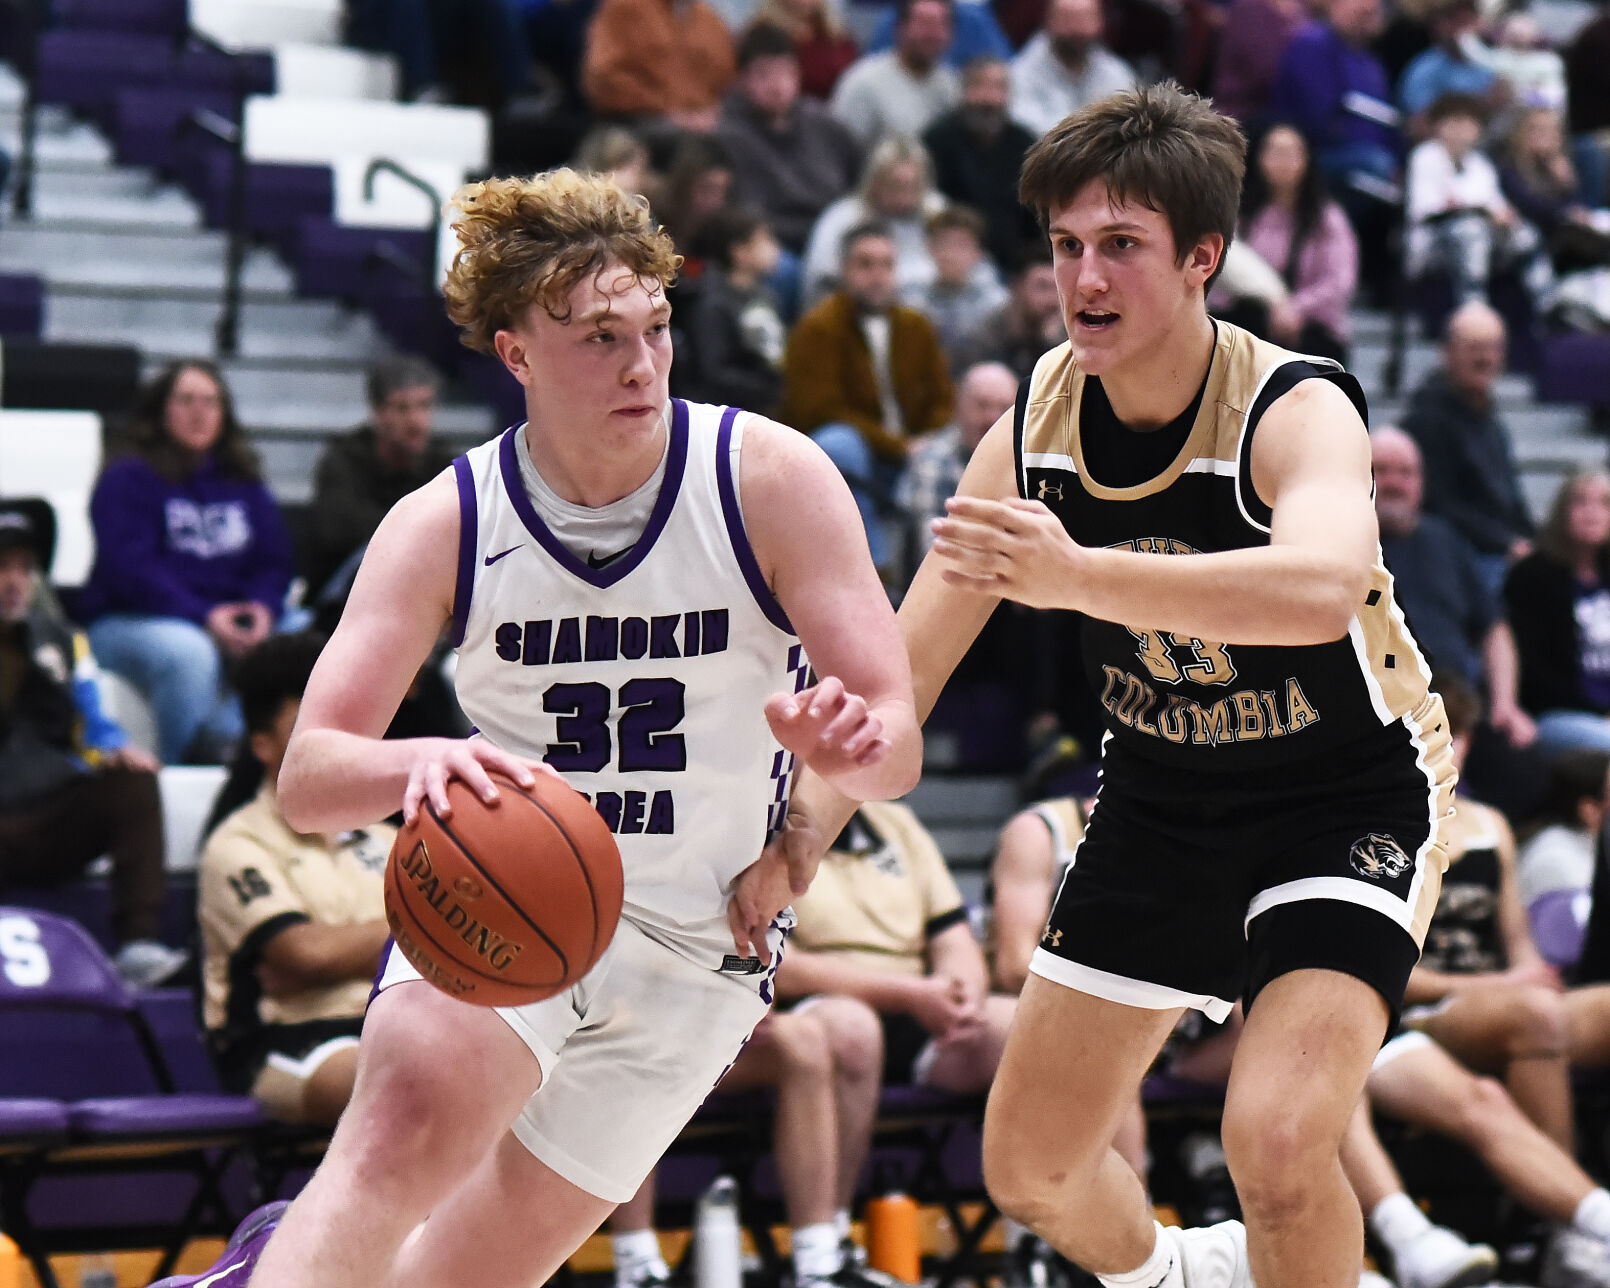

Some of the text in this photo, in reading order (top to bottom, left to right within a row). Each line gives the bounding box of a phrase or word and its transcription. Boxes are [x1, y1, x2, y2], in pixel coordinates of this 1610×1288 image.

[495, 608, 729, 666] SHAMOKIN
[542, 677, 687, 773] 32
[1100, 663, 1321, 748] COLUMBIA
[571, 789, 675, 835] REA
[400, 839, 524, 972] SPALDING
[0, 915, 51, 987] S
